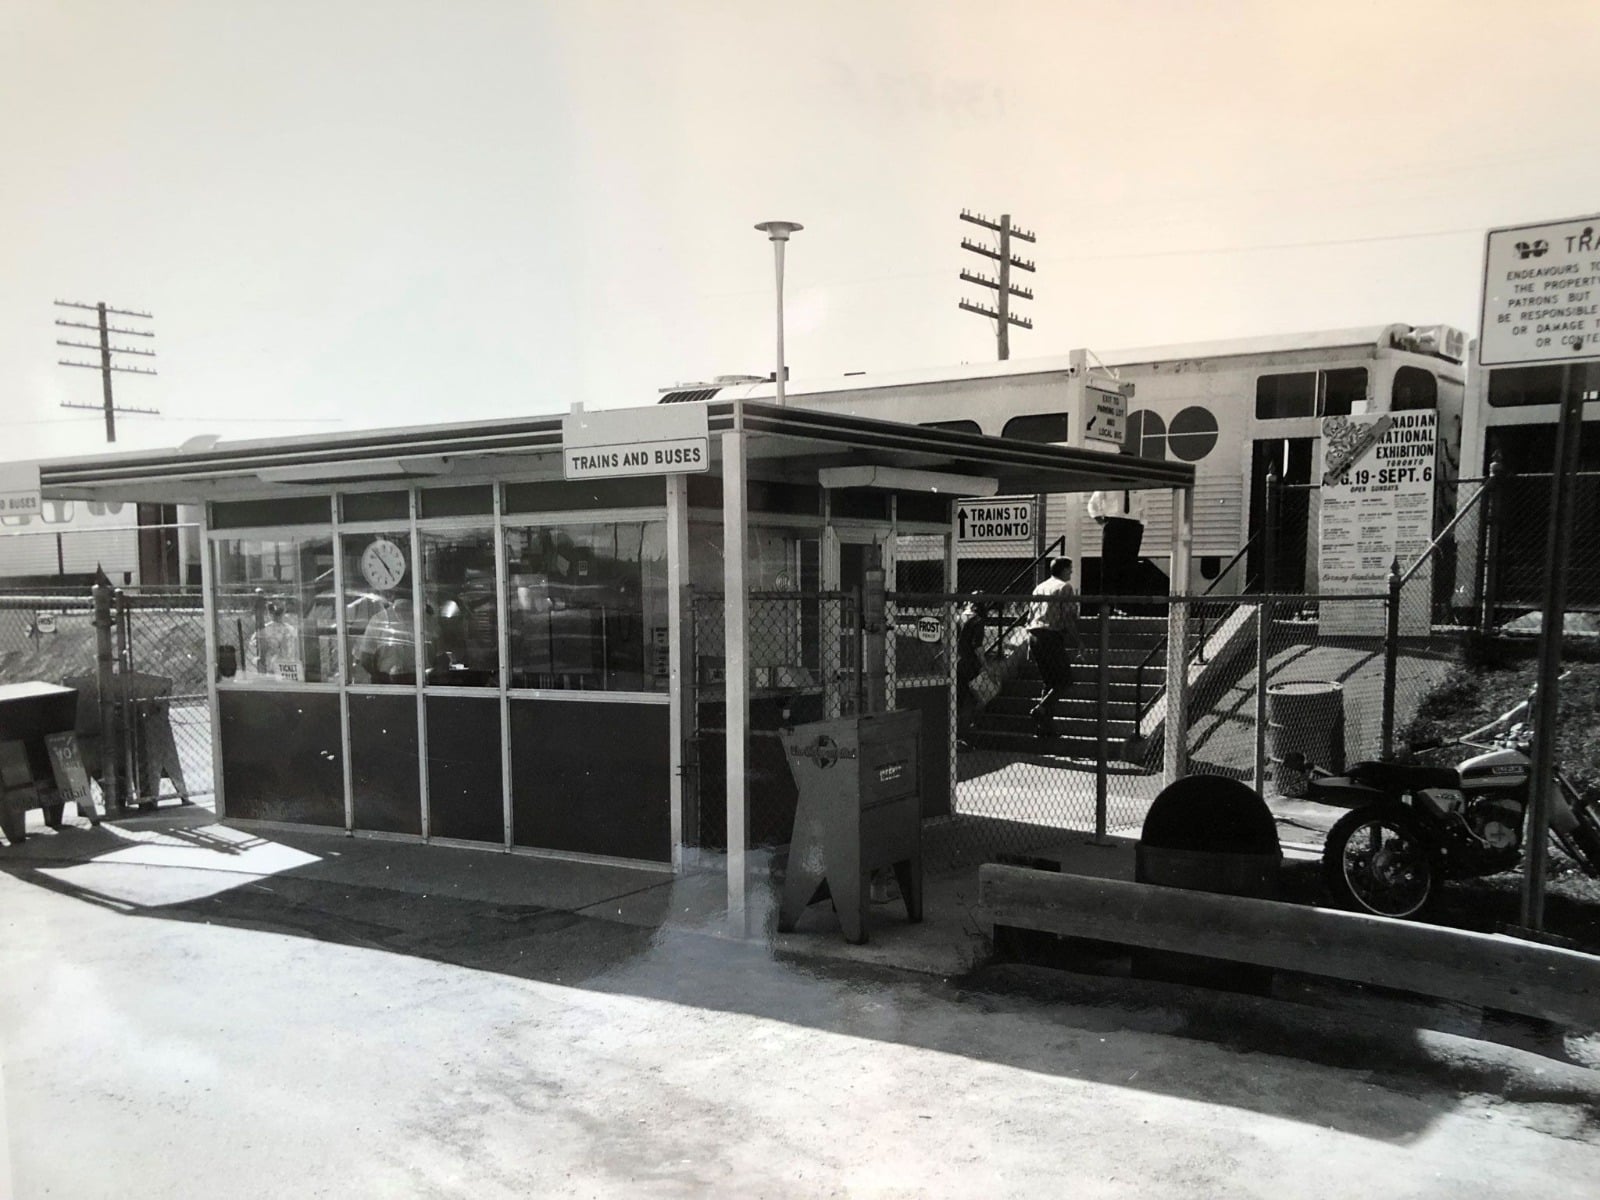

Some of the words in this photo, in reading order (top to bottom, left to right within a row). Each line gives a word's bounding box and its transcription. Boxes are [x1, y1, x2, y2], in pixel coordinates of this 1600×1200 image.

[1506, 264, 1579, 281] ENDEAVOURS
[1514, 282, 1535, 293] THE
[1508, 294, 1559, 307] PATRONS
[1568, 291, 1590, 302] BUT
[1498, 313, 1511, 323] BE
[1521, 304, 1598, 320] RESPONSIBLE
[1512, 326, 1527, 335] OR
[1536, 320, 1584, 333] DAMAGE
[1536, 338, 1551, 347] OR
[572, 453, 619, 470] TRAINS
[623, 451, 648, 467] AND
[655, 447, 701, 465] BUSES
[1376, 444, 1434, 459] EXHIBITION
[1386, 459, 1424, 467] TORONTO
[1355, 470, 1370, 484] 19
[1378, 468, 1420, 484] SEPT.
[1423, 467, 1433, 482] 6
[970, 507, 1011, 521] TRAINS
[1013, 506, 1028, 520] TO
[970, 522, 1029, 537] TORONTO
[920, 621, 940, 632] FROST
